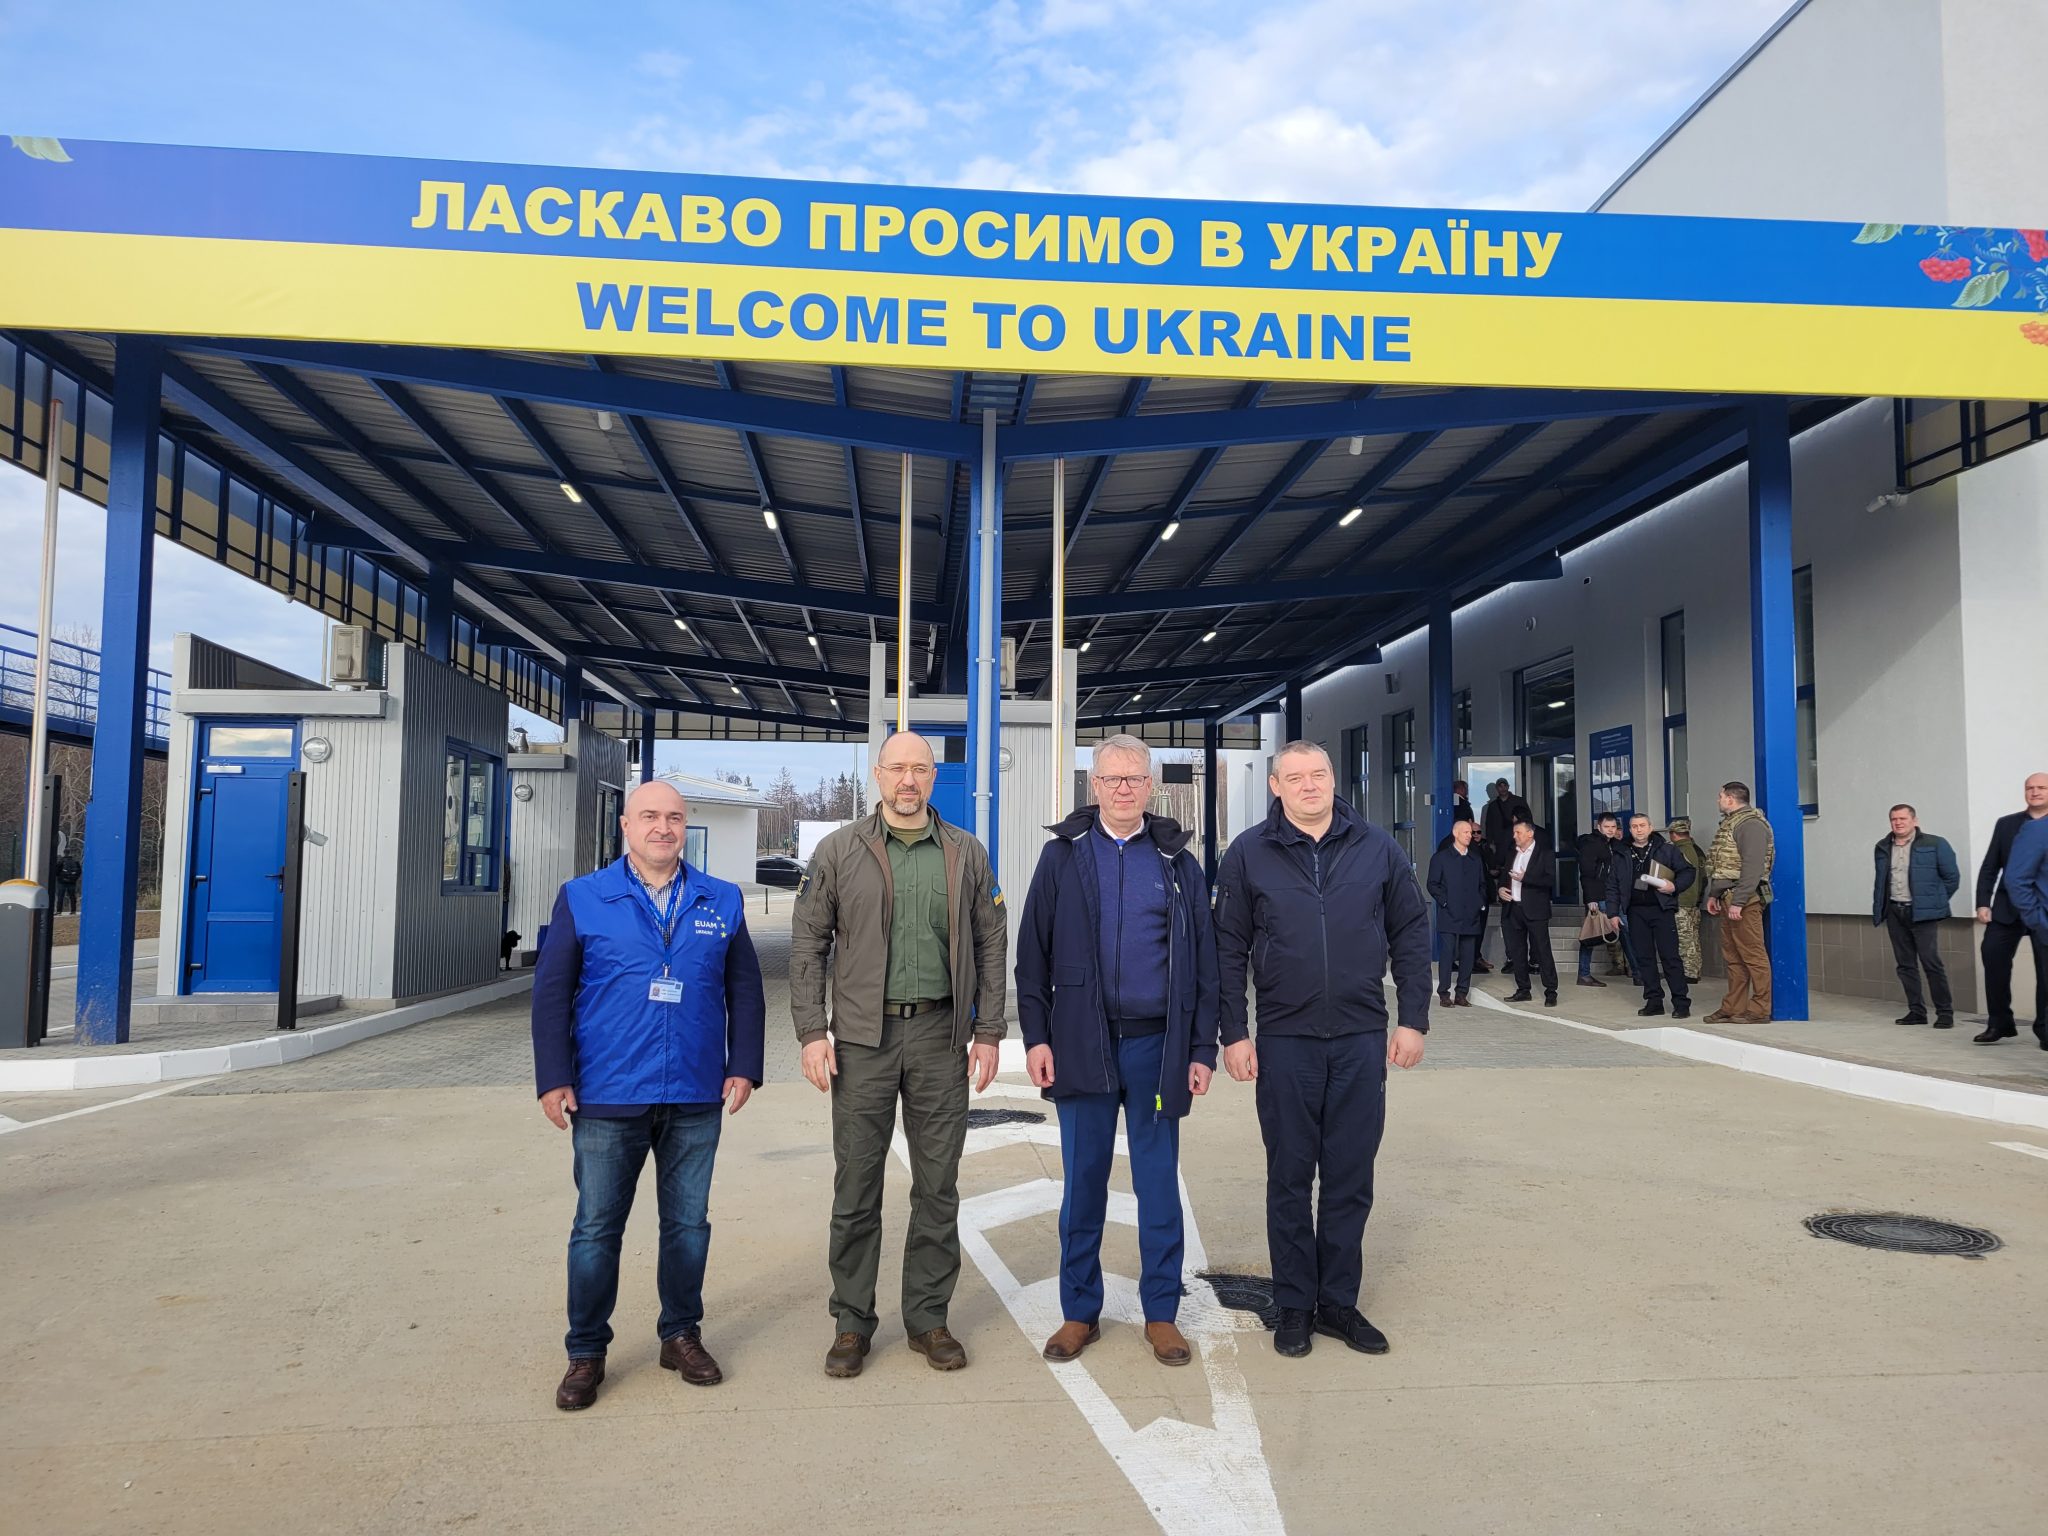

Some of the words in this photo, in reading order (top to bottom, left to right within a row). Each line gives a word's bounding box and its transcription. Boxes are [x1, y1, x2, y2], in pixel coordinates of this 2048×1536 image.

[412, 180, 782, 247] ЛАСКАВО
[810, 202, 1174, 266] ПРОСИМО
[1201, 221, 1243, 268] В
[1267, 218, 1562, 278] УКРАЇНУ
[576, 282, 947, 347] WELCOME
[972, 301, 1067, 352] TO
[1093, 306, 1412, 363] UKRAINE
[694, 920, 718, 930] EUAM
